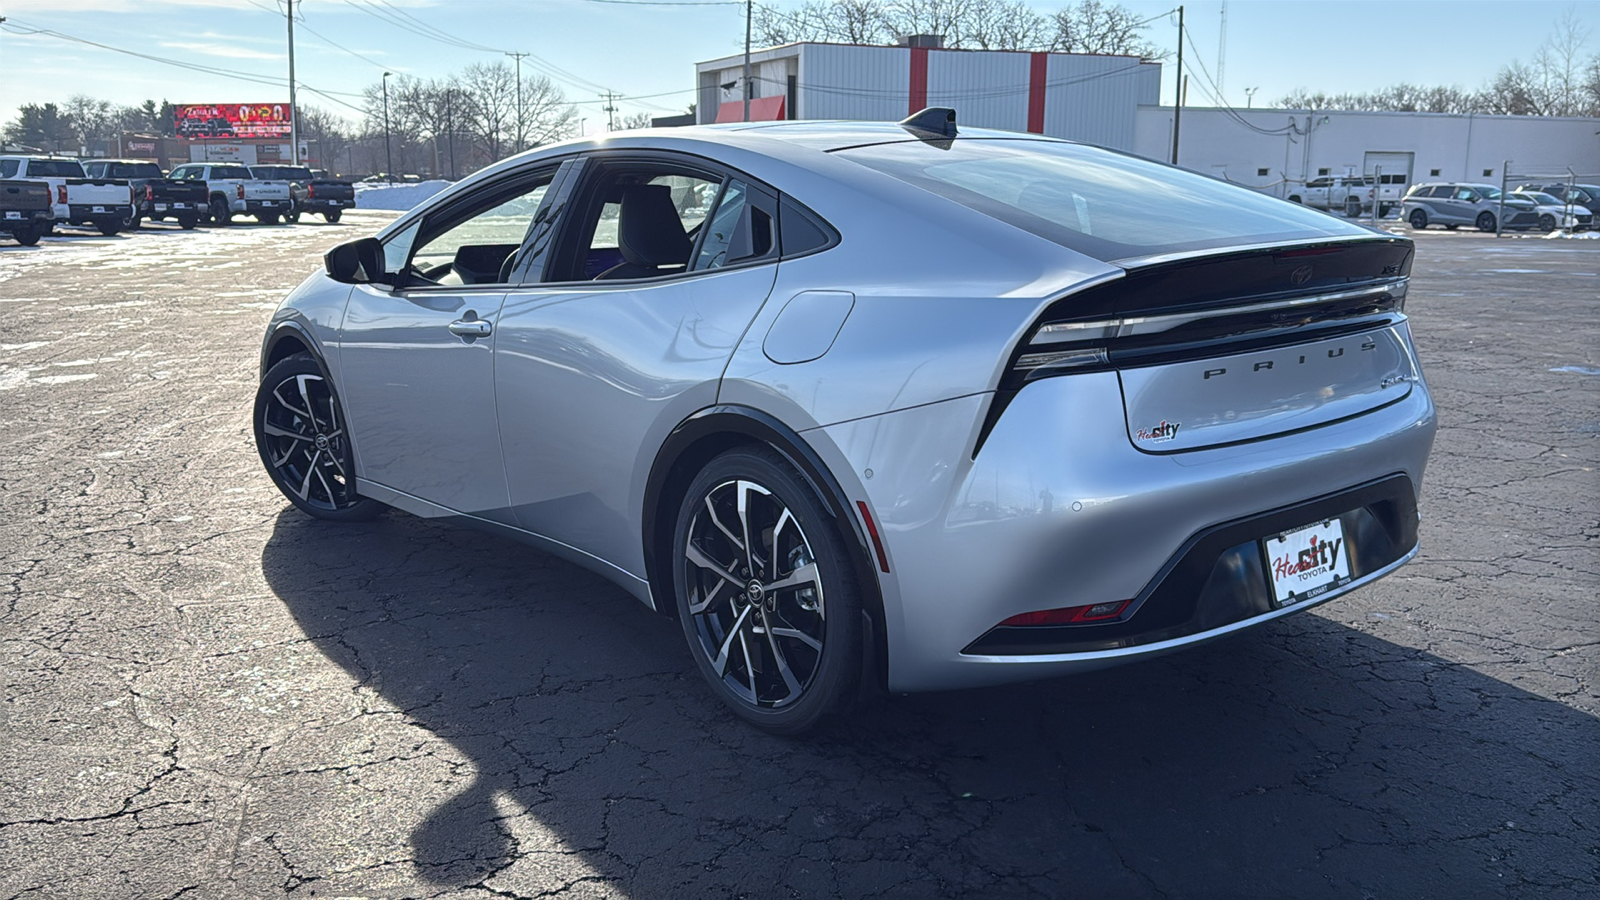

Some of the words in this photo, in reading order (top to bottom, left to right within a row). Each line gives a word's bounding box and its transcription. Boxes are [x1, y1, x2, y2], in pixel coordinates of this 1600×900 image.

[1203, 341, 1376, 380] PRIUS
[1298, 566, 1328, 582] TOYOTA
[1306, 585, 1328, 598] ELKHART
